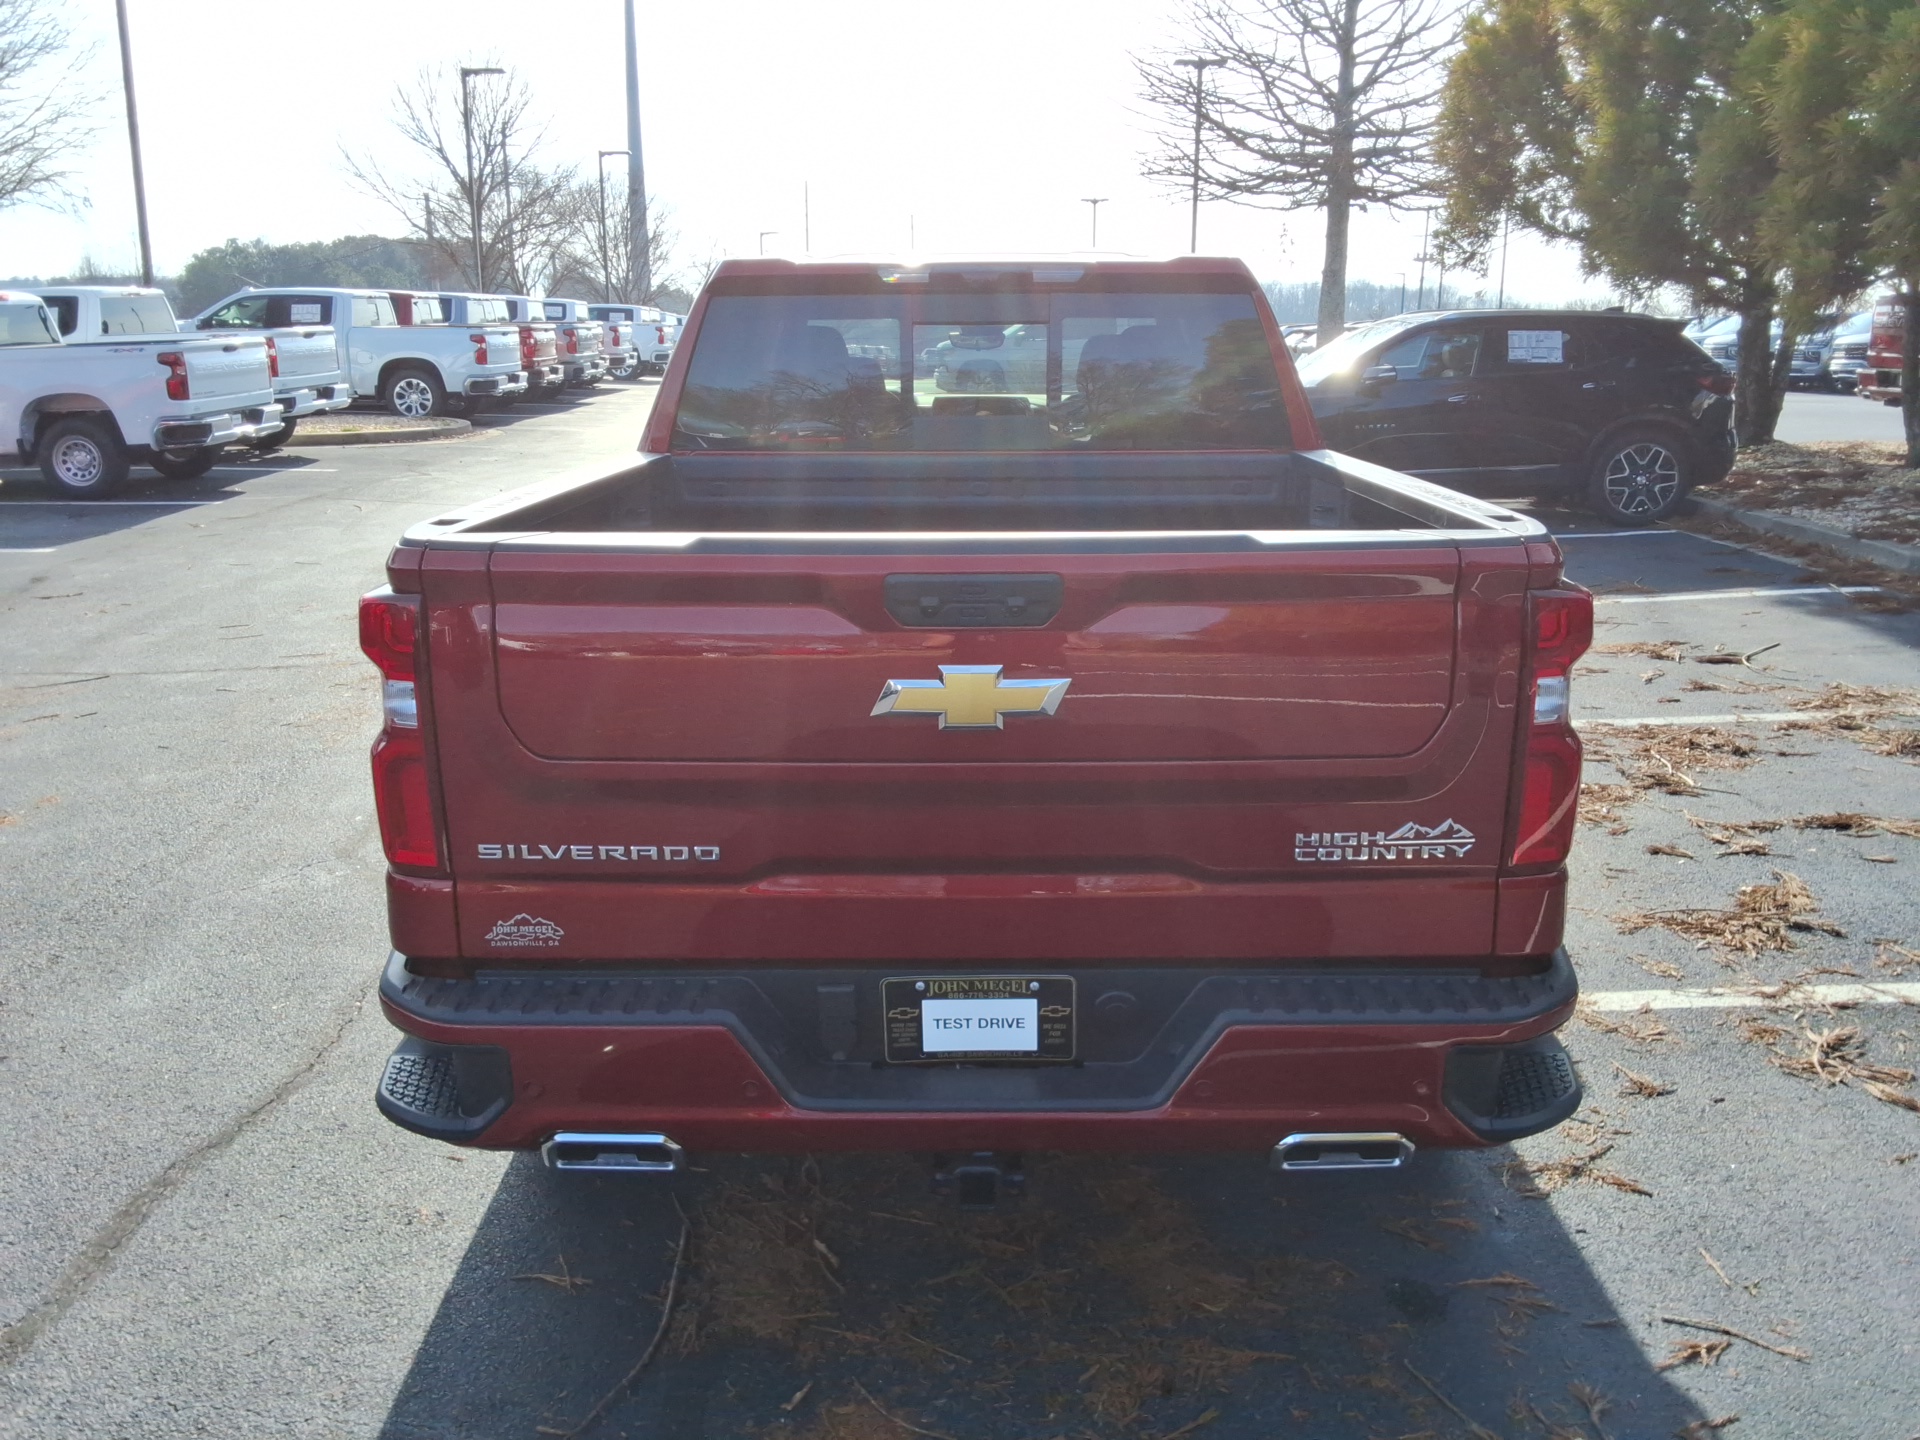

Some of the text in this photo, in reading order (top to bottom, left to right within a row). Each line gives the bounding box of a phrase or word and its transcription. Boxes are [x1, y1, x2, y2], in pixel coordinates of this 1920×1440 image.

[1295, 831, 1385, 845] HIGH
[477, 843, 720, 861] SILVERADO
[1294, 844, 1474, 861] COUNTRY
[492, 925, 554, 936] JOHN MEGEL
[926, 980, 1031, 997] JOHN MEGEL
[932, 1017, 1026, 1029] TEST DRIVE
